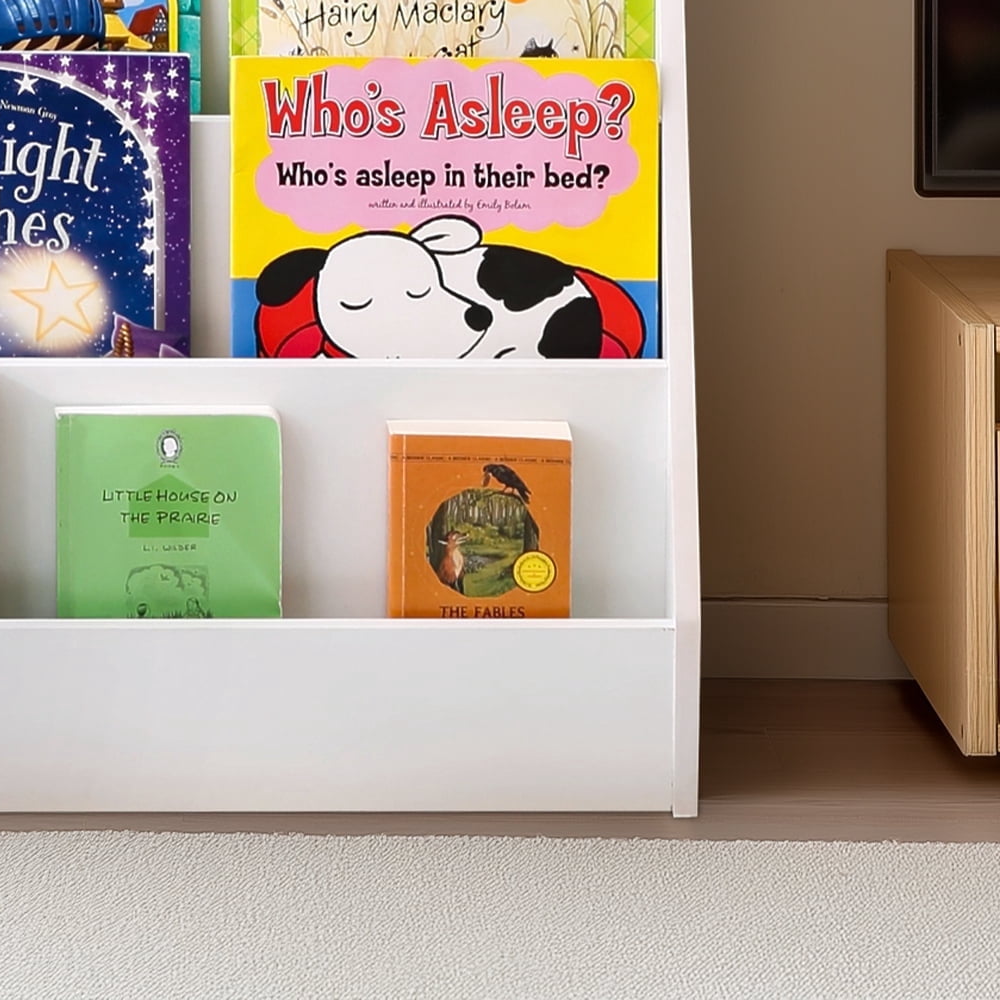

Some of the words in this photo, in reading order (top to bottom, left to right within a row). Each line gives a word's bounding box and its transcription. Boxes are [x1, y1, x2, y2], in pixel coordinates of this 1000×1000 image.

[261, 71, 405, 139] Who's
[420, 72, 635, 160] Asleep?
[276, 161, 346, 187] Who's
[356, 159, 435, 195] asleep
[444, 162, 465, 187] in
[474, 162, 535, 188] their
[544, 162, 611, 189] bed?
[368, 199, 398, 208] written
[400, 199, 416, 208] and
[417, 199, 462, 208] illustrated
[464, 199, 474, 212] by
[476, 199, 502, 212] Emily
[103, 489, 153, 502] LITTLE
[156, 489, 210, 503] HOUSE
[213, 490, 237, 504] ON
[120, 512, 150, 524] THE
[156, 511, 221, 525] PRAIRIE
[439, 606, 468, 618] THE
[474, 606, 526, 618] FABLES
